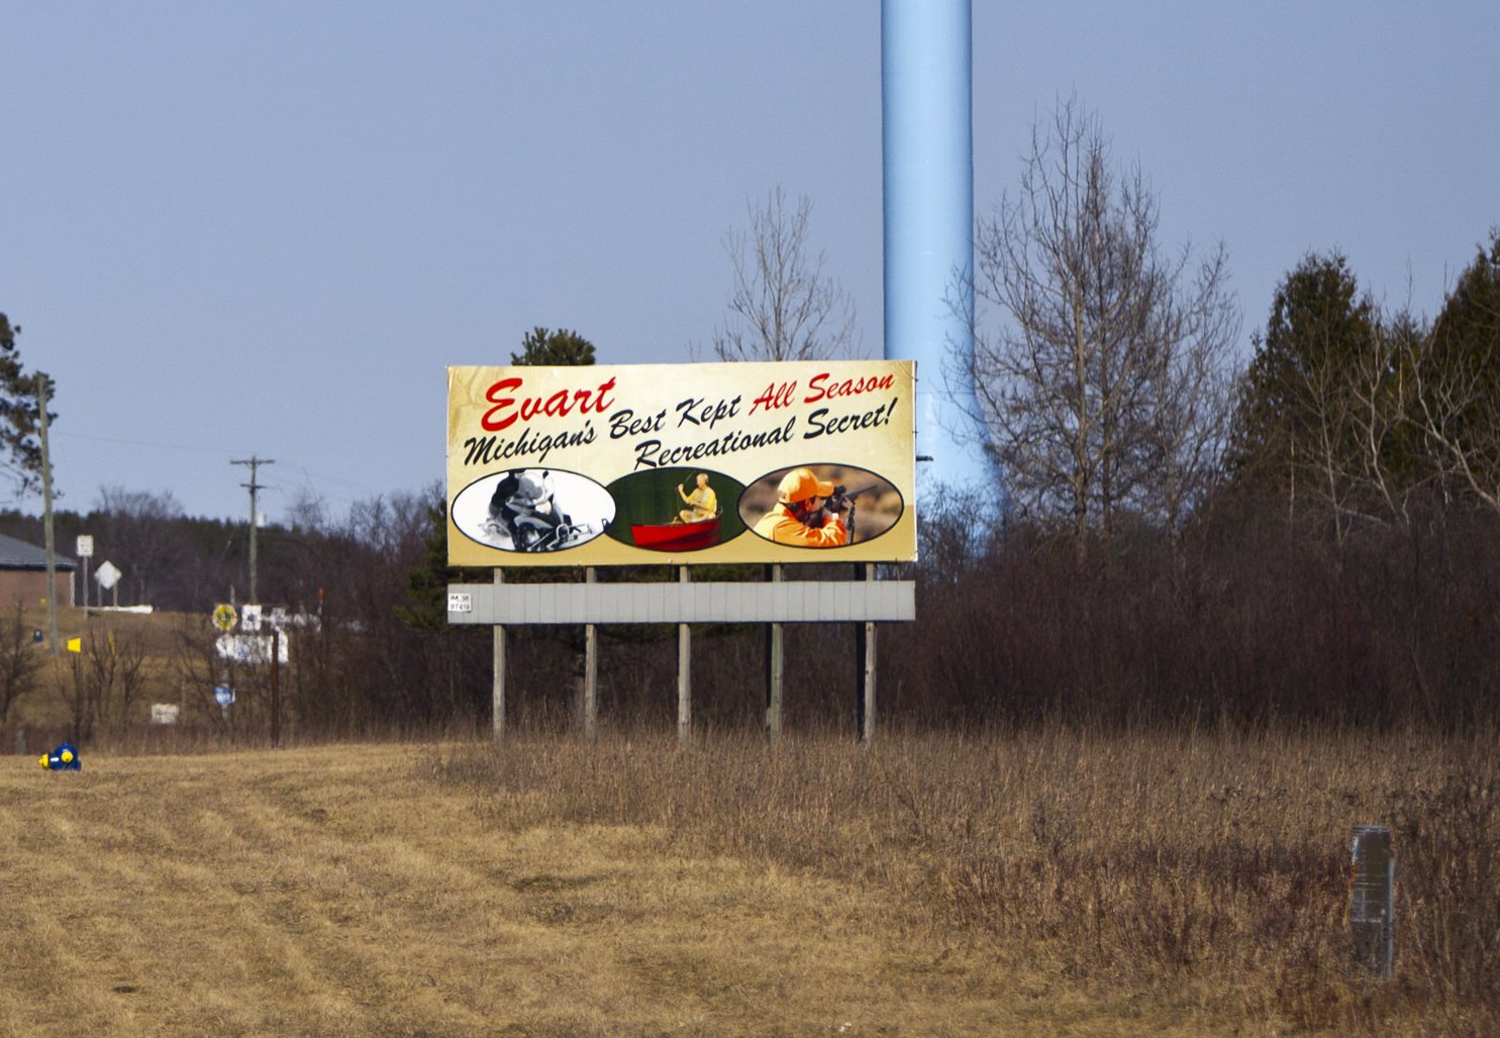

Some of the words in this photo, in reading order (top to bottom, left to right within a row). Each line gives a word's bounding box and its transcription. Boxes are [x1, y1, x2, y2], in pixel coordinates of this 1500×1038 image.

[463, 419, 598, 466] Michigan's
[608, 408, 667, 440] Best
[675, 394, 743, 431] Kept
[748, 380, 798, 416] All
[803, 372, 895, 404] Season
[481, 376, 617, 432] Evart
[633, 415, 797, 471] Recreational
[803, 396, 898, 440] Secret!
